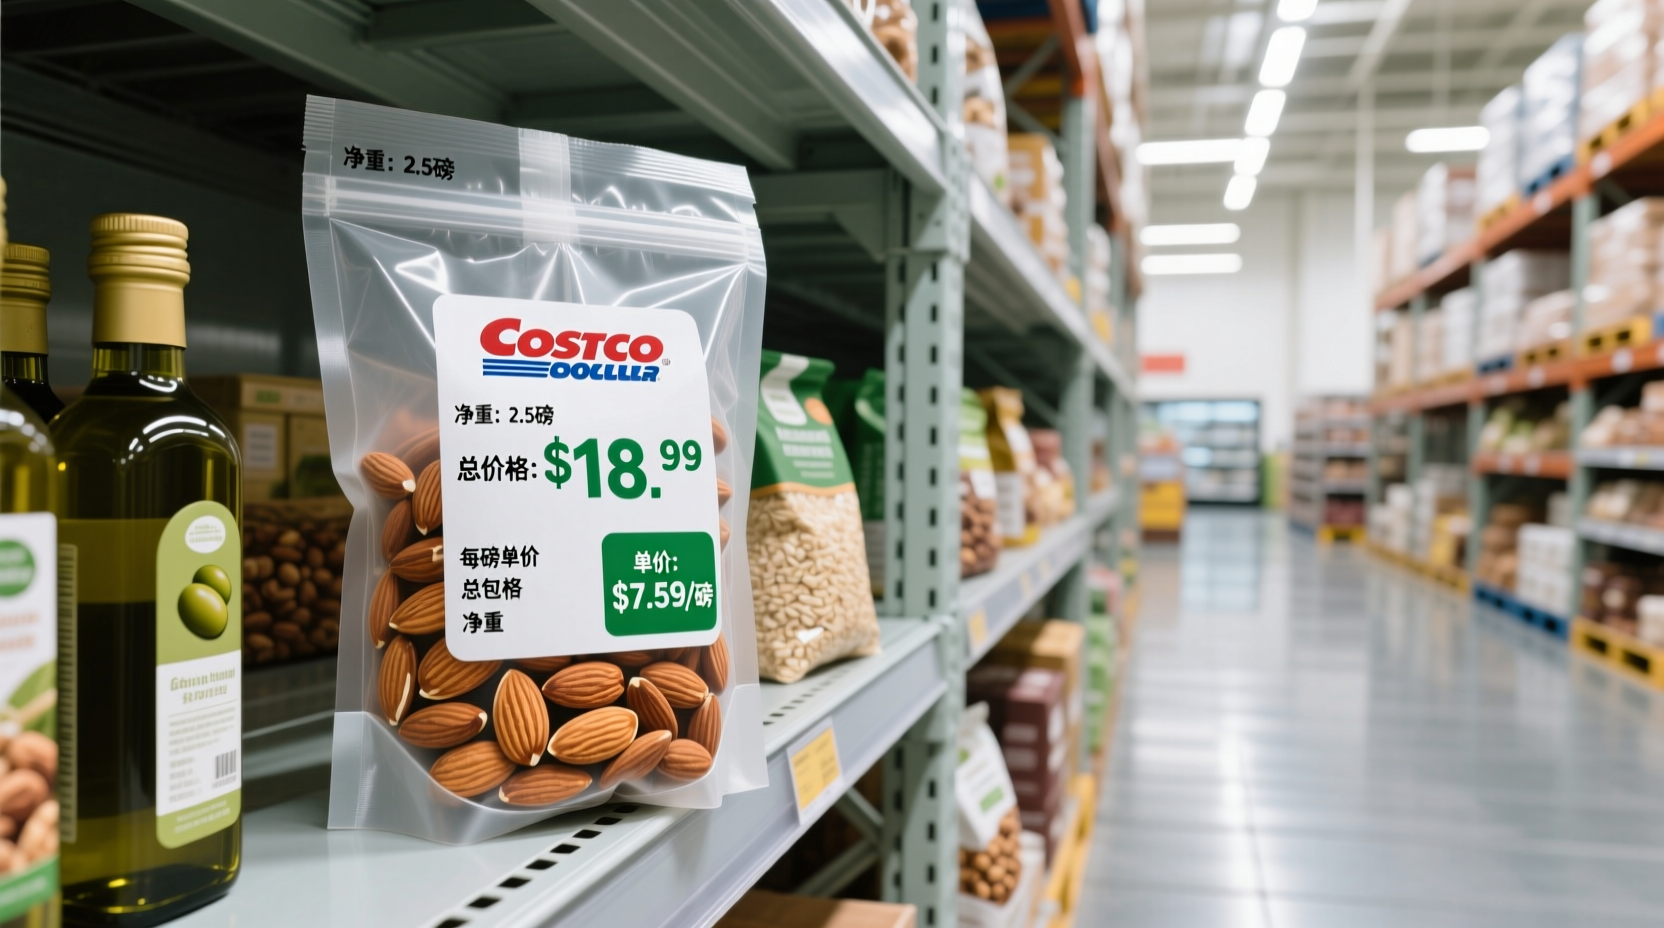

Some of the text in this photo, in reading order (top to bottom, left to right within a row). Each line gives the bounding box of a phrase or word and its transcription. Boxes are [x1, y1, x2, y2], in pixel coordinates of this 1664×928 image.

[480, 317, 664, 363] COSTCO
[459, 545, 540, 570] 每磅单价
[461, 577, 523, 601] 总包格
[612, 579, 714, 614] $7.59/磅
[462, 610, 504, 634] 净重
